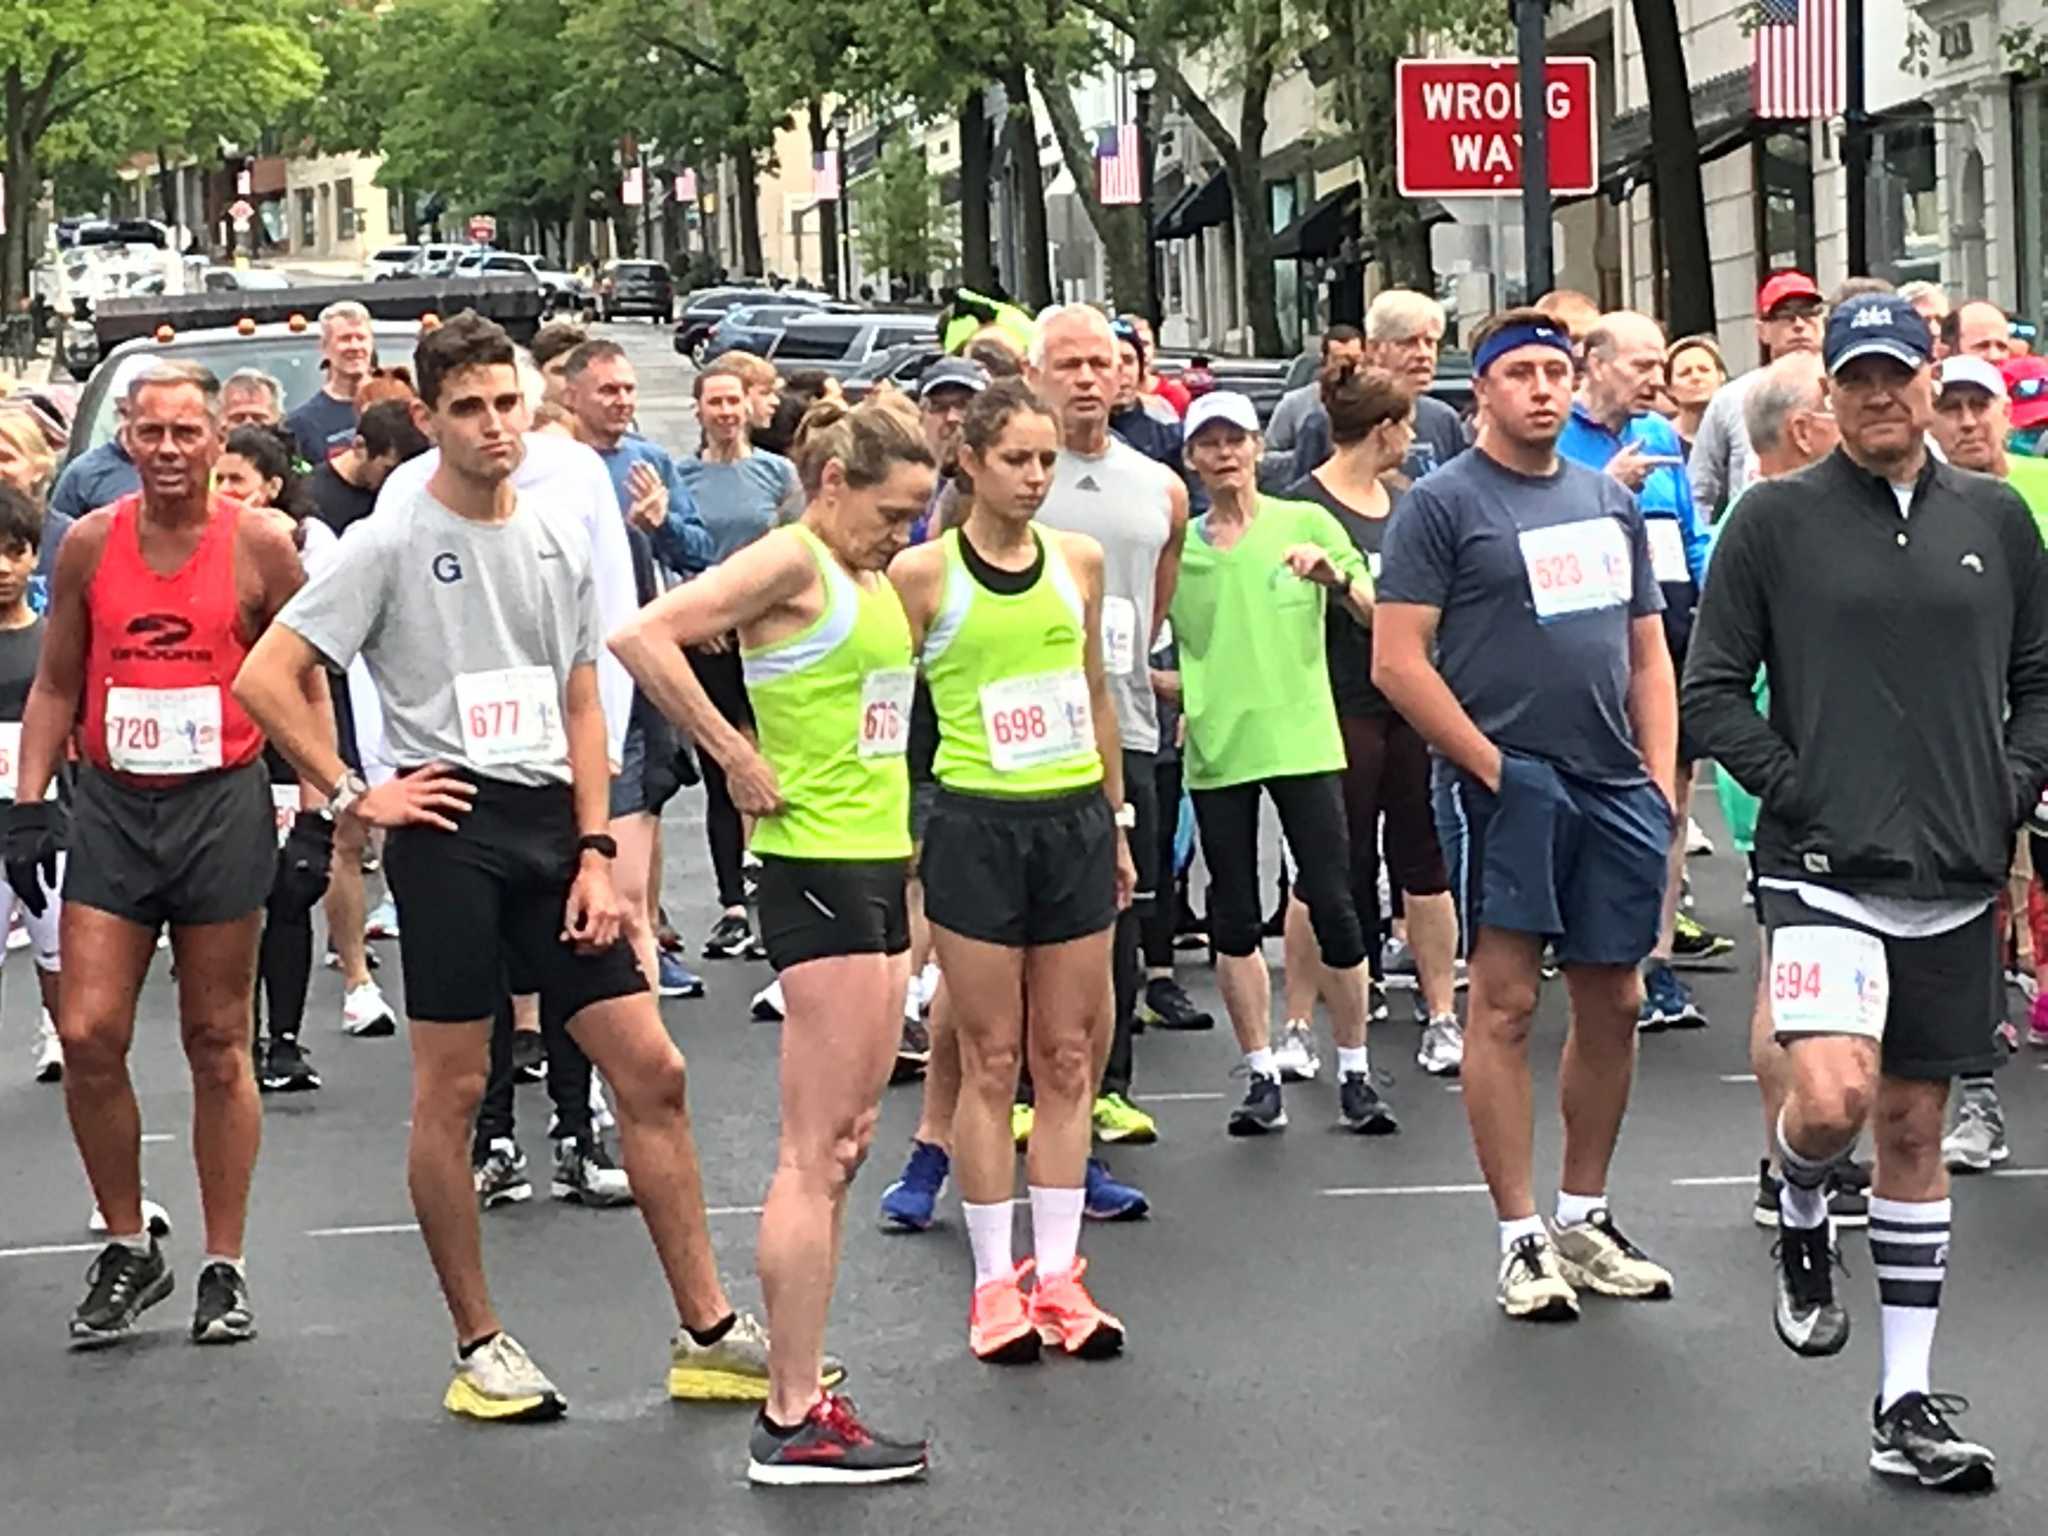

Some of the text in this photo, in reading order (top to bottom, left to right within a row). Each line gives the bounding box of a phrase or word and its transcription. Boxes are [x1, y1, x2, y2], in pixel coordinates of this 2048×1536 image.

[432, 552, 463, 583] G
[1535, 552, 1583, 590] 523
[113, 716, 159, 749] 720
[469, 700, 521, 738] 677
[864, 700, 898, 740] 676
[992, 705, 1047, 745] 698
[1775, 961, 1821, 999] 594
